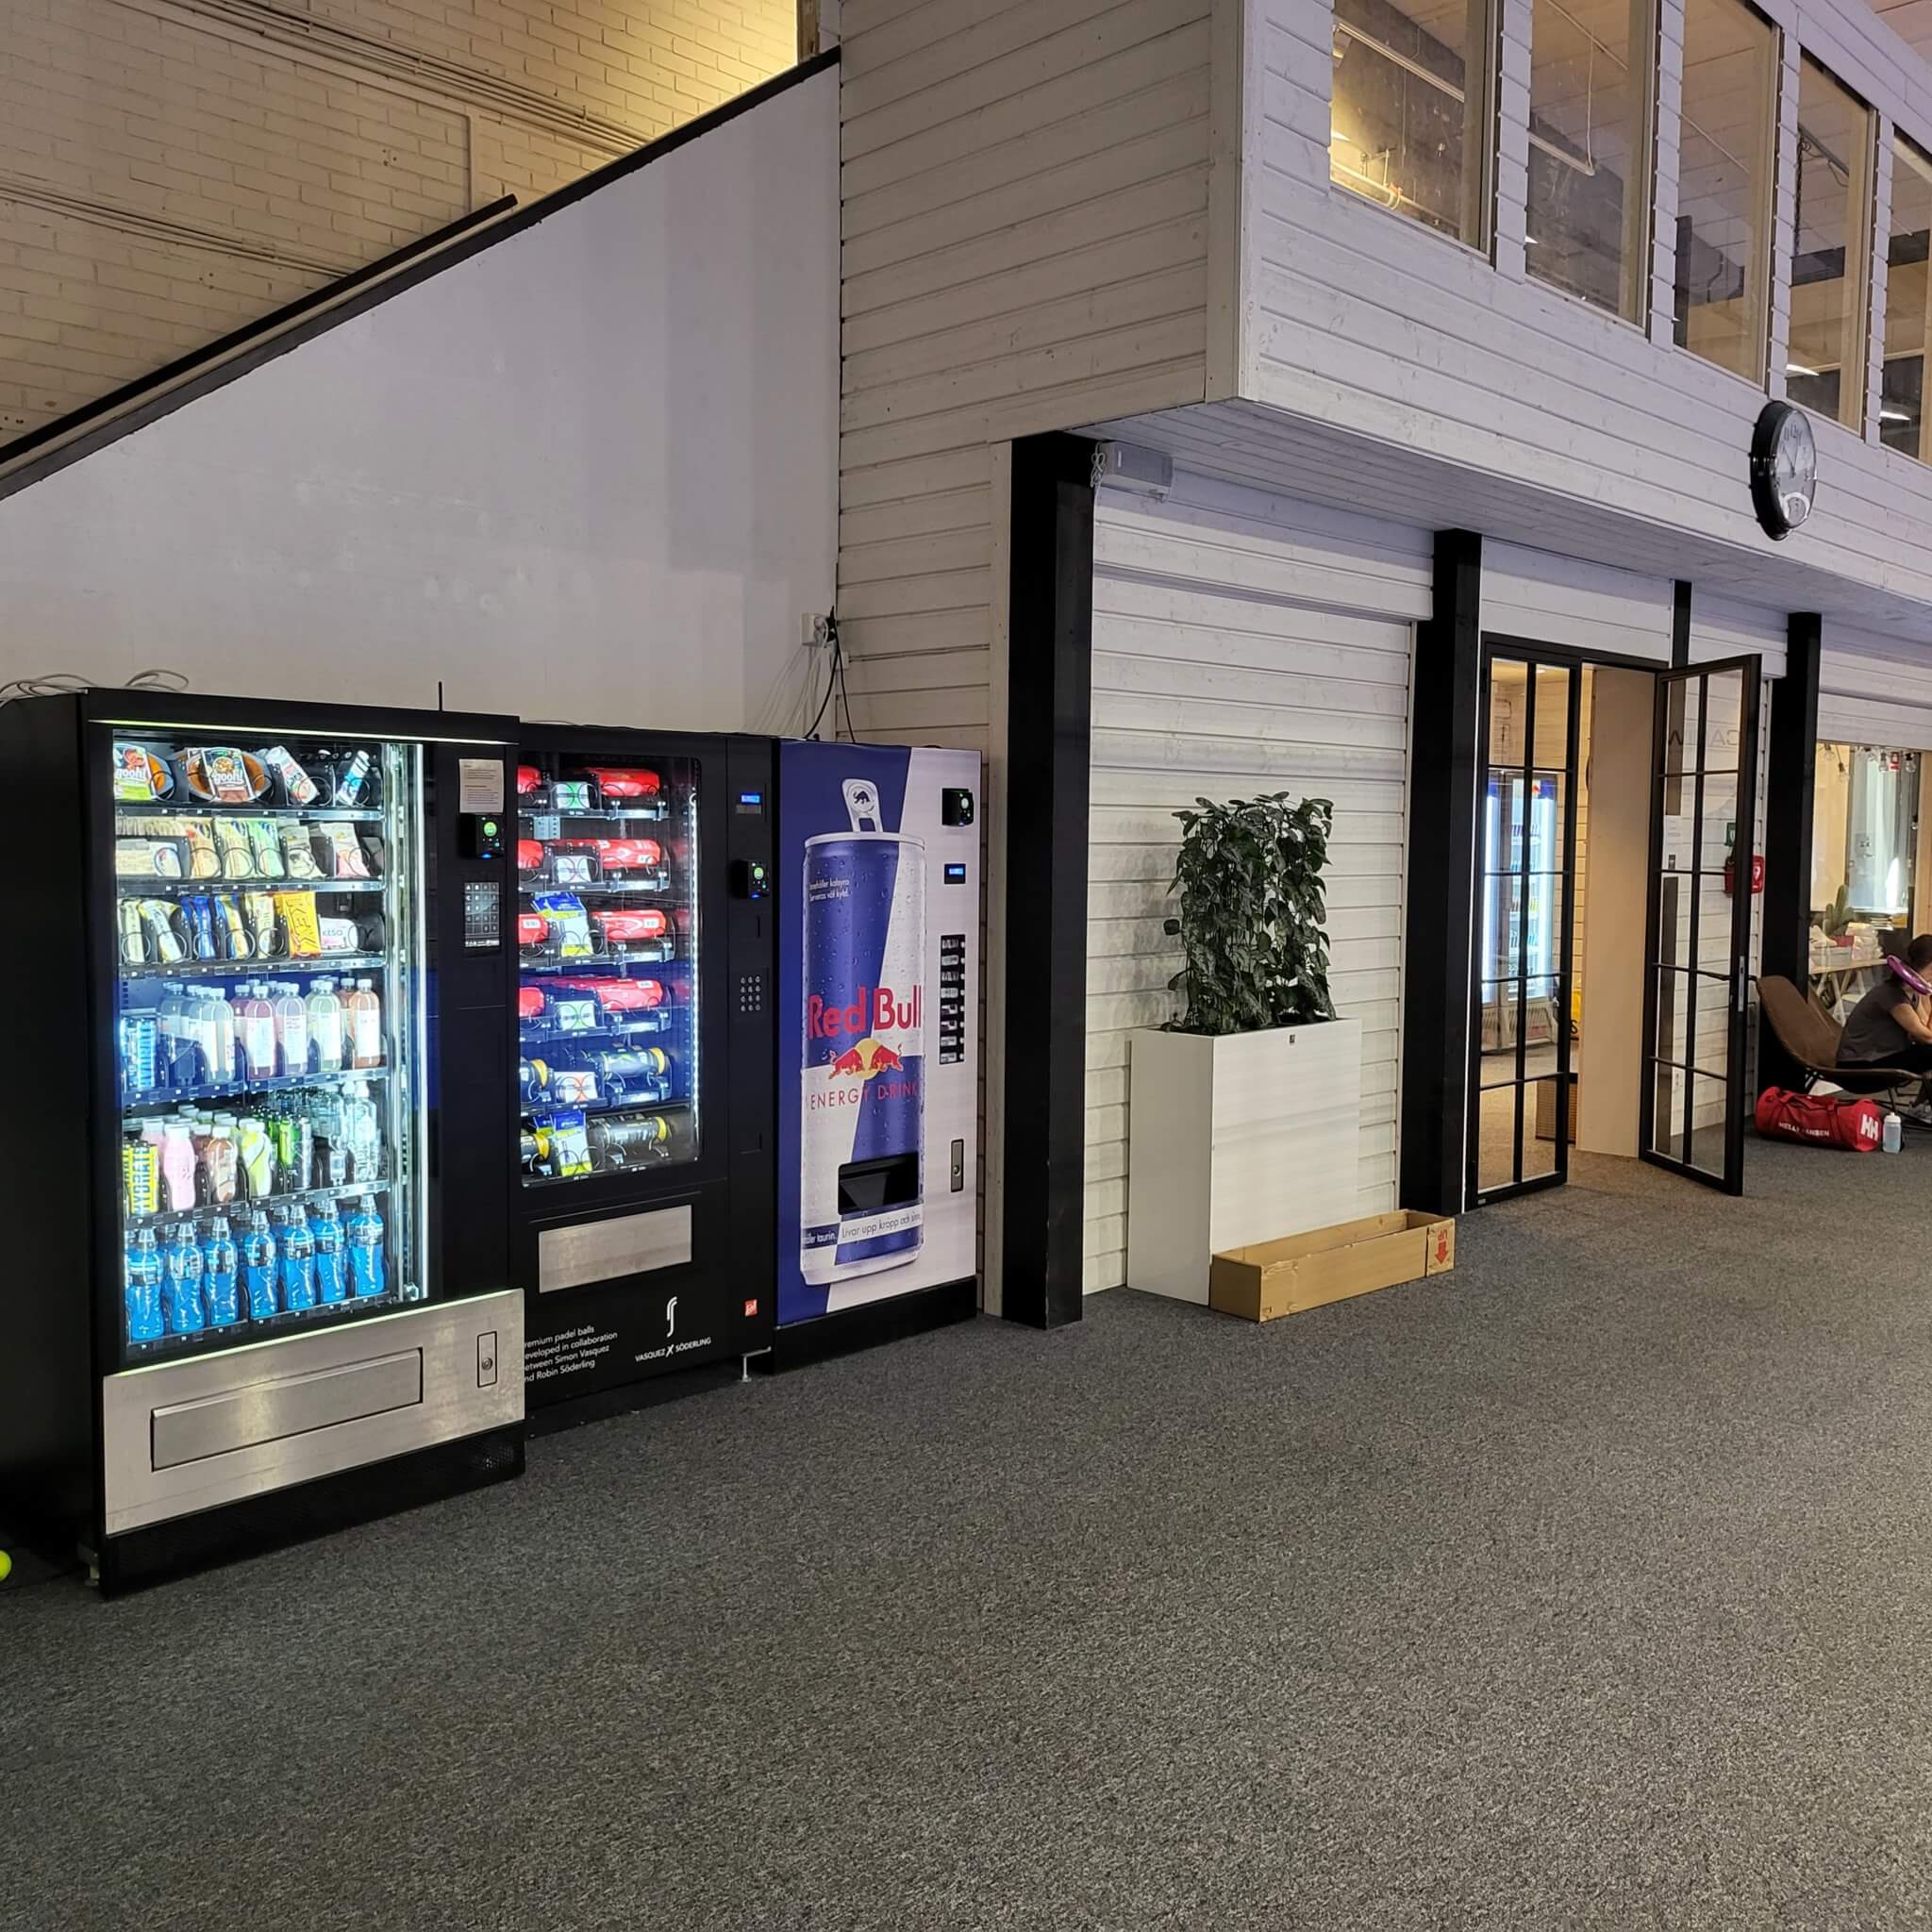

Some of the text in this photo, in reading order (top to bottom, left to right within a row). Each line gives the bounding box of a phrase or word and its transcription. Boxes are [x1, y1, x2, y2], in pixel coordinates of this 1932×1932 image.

[808, 986, 867, 1041] Red
[874, 984, 922, 1031] Bull
[810, 1081, 919, 1110] ENERGY DRINK
[861, 1224, 877, 1235] upp
[878, 1218, 899, 1231] kropp
[525, 1324, 595, 1349] remium padel balls
[525, 1332, 619, 1360] eveloped in collaboration
[635, 1347, 666, 1362] VASQUEZ
[675, 1336, 712, 1353] SÖDERLING
[525, 1344, 610, 1372] etween Simon Vasquez
[525, 1358, 596, 1382] nd Robin Söderling
